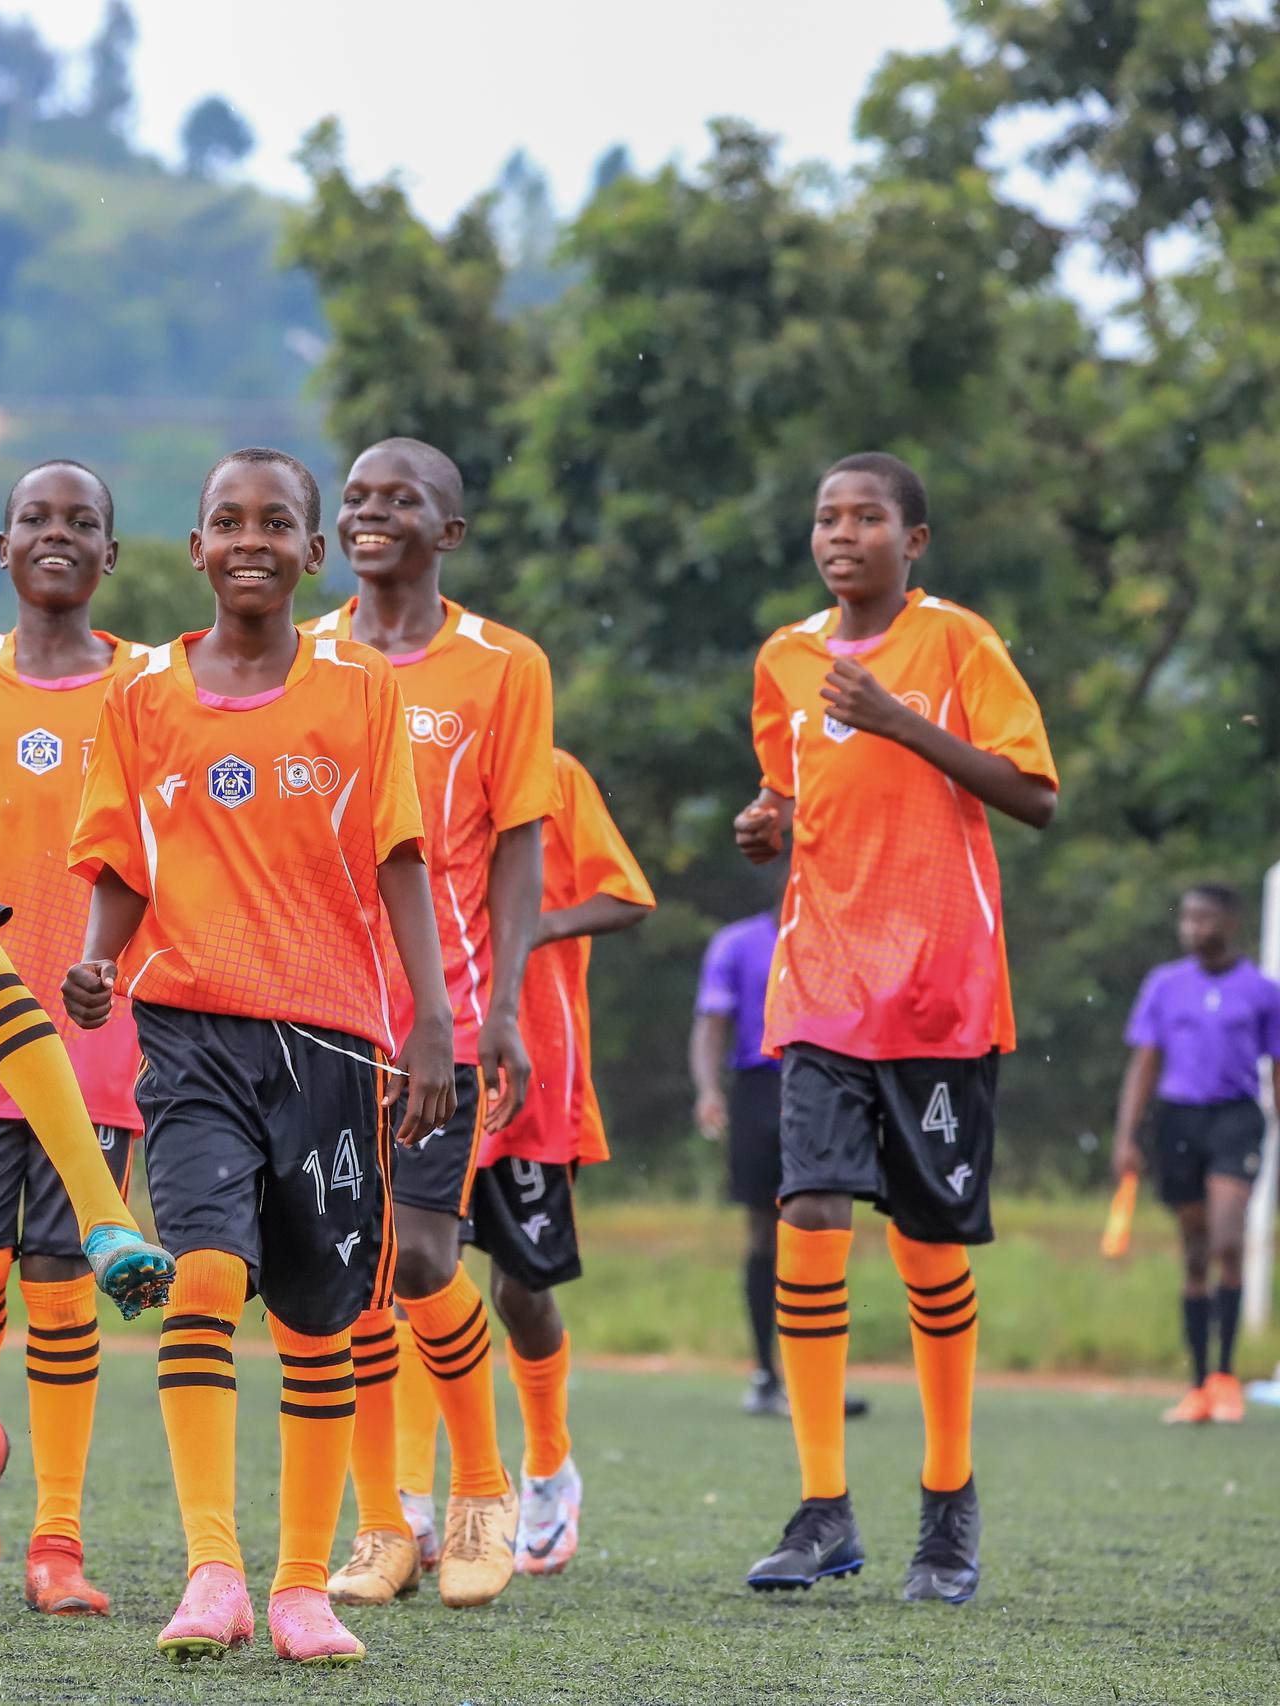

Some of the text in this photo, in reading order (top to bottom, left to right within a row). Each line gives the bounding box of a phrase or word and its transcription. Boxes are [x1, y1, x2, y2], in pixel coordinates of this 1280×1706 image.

[273, 753, 340, 799] 100
[921, 1081, 959, 1144] 4
[302, 1128, 364, 1215] 14
[510, 1156, 546, 1204] 9
